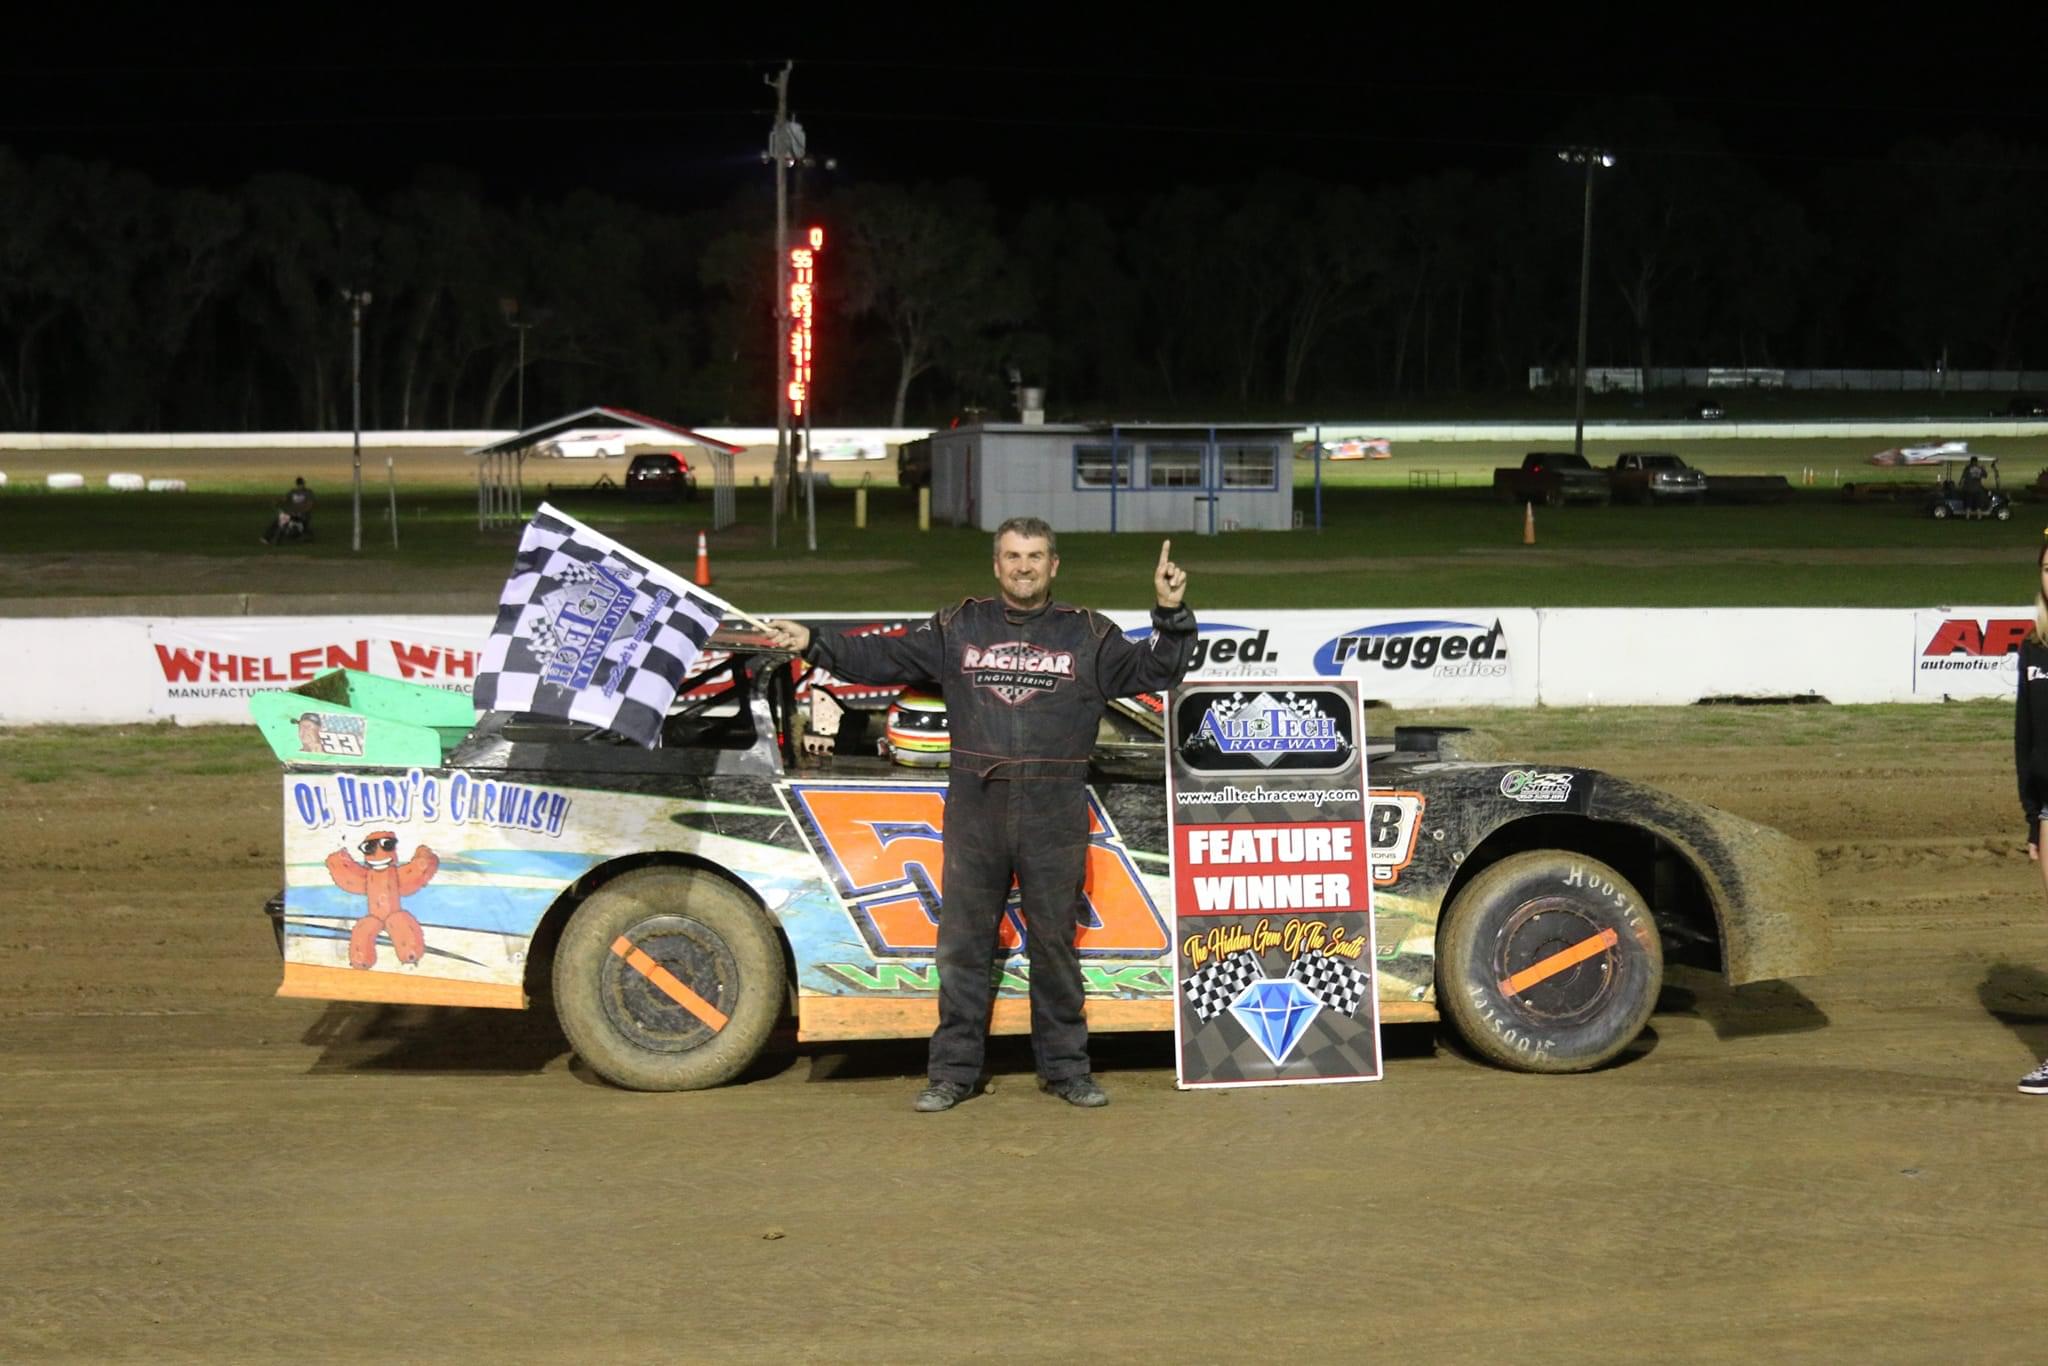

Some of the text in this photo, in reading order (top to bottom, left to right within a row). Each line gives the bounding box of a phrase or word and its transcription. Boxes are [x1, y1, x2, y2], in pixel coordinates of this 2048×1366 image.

[154, 638, 369, 682] WHELEN
[1180, 629, 1278, 671] ged.
[1333, 616, 1507, 670] rugged.
[1433, 660, 1506, 678] radios
[1921, 659, 1998, 671] automotive
[320, 732, 362, 755] 33
[1229, 738, 1331, 750] RACEWAY
[294, 769, 569, 834] OL HAIRY'S CARWASH
[1177, 787, 1359, 806] www.alltechraceway.com
[1188, 827, 1352, 864] FEATURE
[1193, 873, 1351, 911] WINNER
[1184, 918, 1367, 970] The Hidden Gem Of The South
